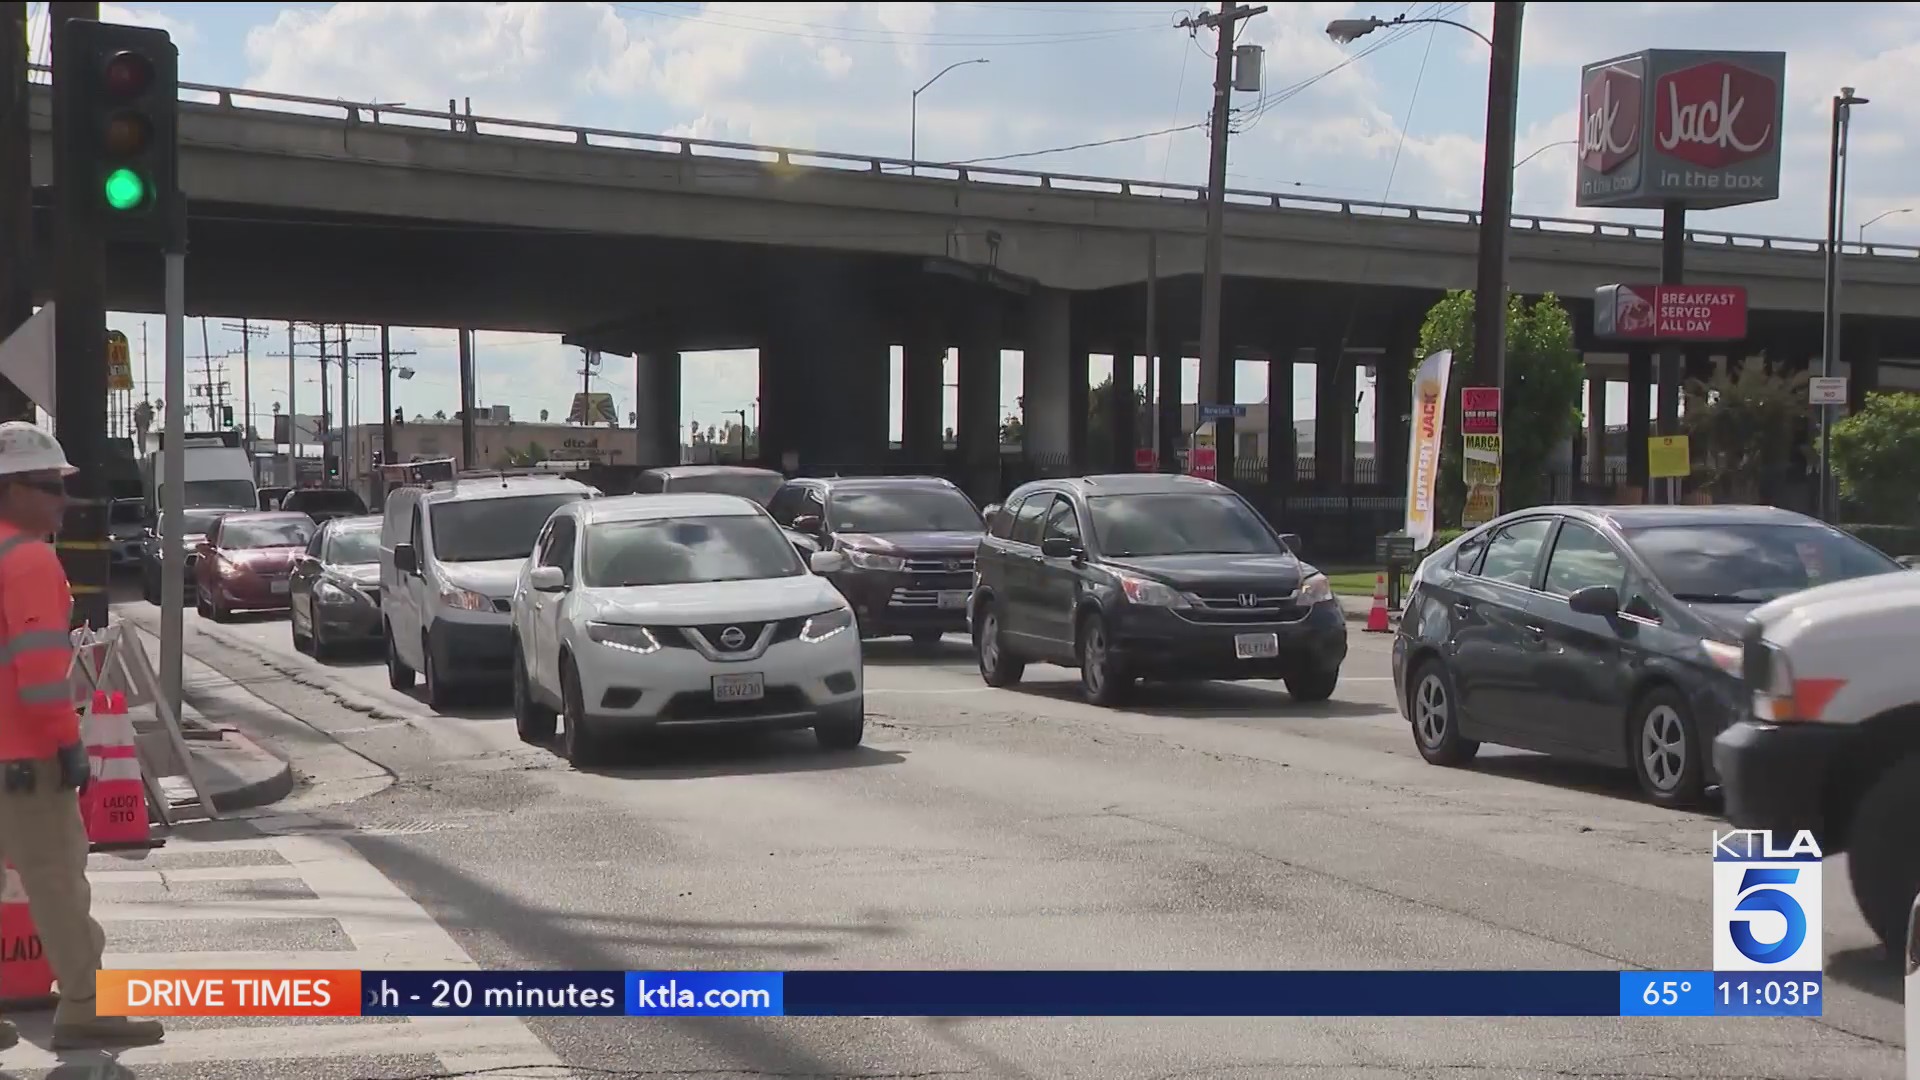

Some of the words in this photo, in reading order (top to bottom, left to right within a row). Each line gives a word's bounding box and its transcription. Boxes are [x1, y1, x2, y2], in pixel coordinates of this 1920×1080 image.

[1580, 79, 1636, 160] Jack
[1659, 73, 1771, 152] Jack
[1661, 170, 1679, 186] in
[1685, 171, 1719, 188] the
[1725, 172, 1764, 188] box
[1661, 293, 1735, 305] BREAKFAST
[1660, 307, 1711, 318] SERVED
[1660, 320, 1683, 331] ALL
[1687, 320, 1711, 331] DAY
[1422, 392, 1438, 438] JACK
[1466, 436, 1500, 448] MARCA
